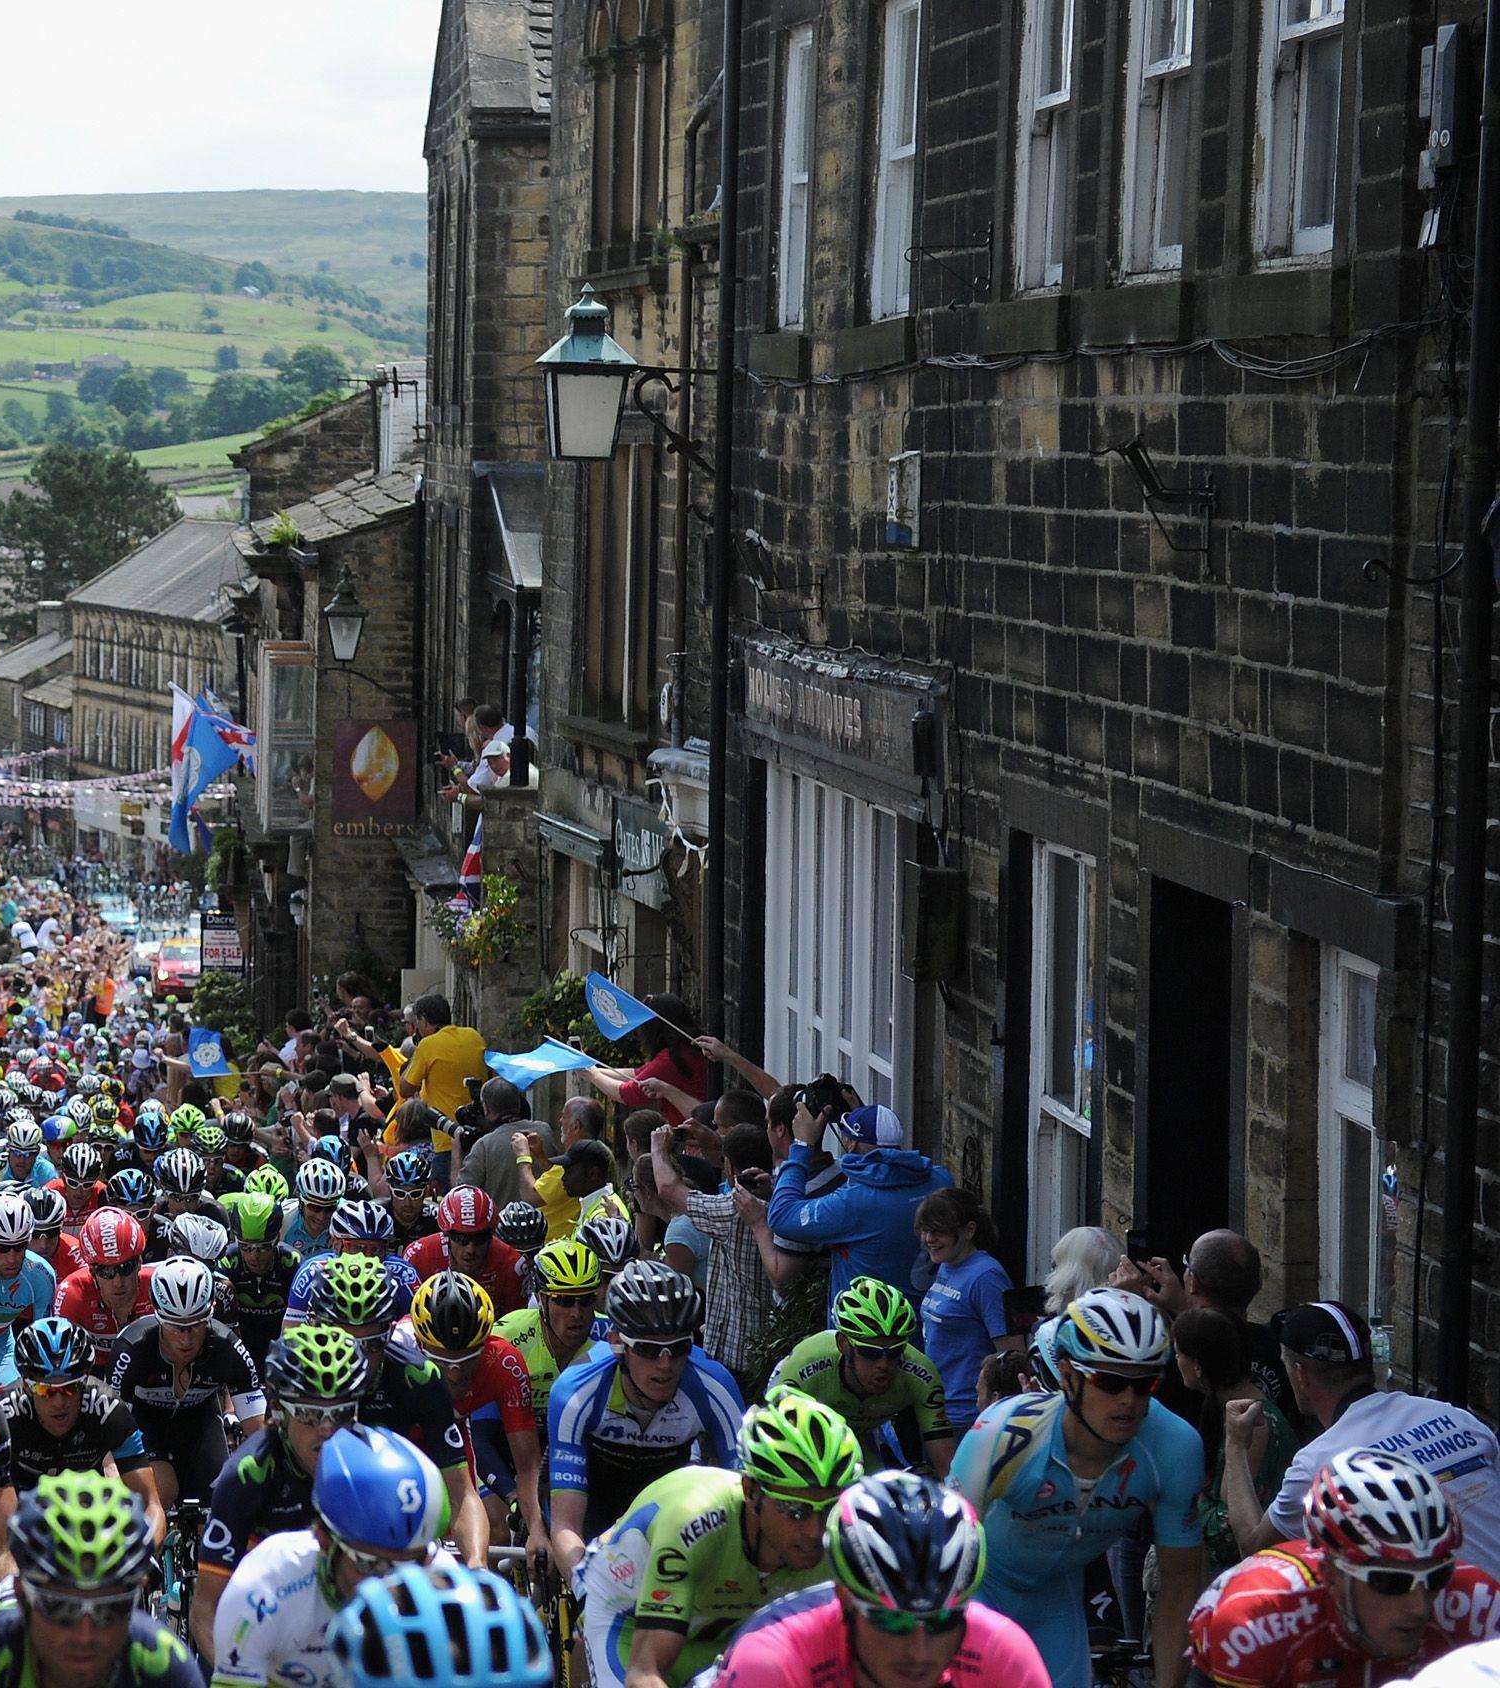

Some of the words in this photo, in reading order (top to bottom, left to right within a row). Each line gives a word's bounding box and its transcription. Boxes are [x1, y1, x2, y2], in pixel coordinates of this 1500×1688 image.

[798, 683, 862, 743] ANTIQUES
[333, 816, 415, 837] embers
[204, 947, 220, 958] FOR
[222, 947, 242, 958] SALE
[114, 1148, 133, 1160] sky
[347, 1176, 368, 1193] sky
[156, 1222, 171, 1239] sk
[54, 1280, 69, 1316] KER+
[111, 1352, 132, 1397] atexco
[798, 1358, 833, 1381] KENDA
[0, 1387, 33, 1420] sky
[81, 1388, 120, 1425] sky
[626, 1432, 677, 1443] NetApp
[1369, 1433, 1411, 1451] RUN
[1406, 1415, 1457, 1441] WITH
[1412, 1430, 1478, 1465] RHINOS
[555, 1471, 588, 1485] BORA
[1011, 1495, 1147, 1520] ASTANA
[680, 1508, 728, 1549] KENDA
[1220, 1597, 1318, 1669] JOKER+
